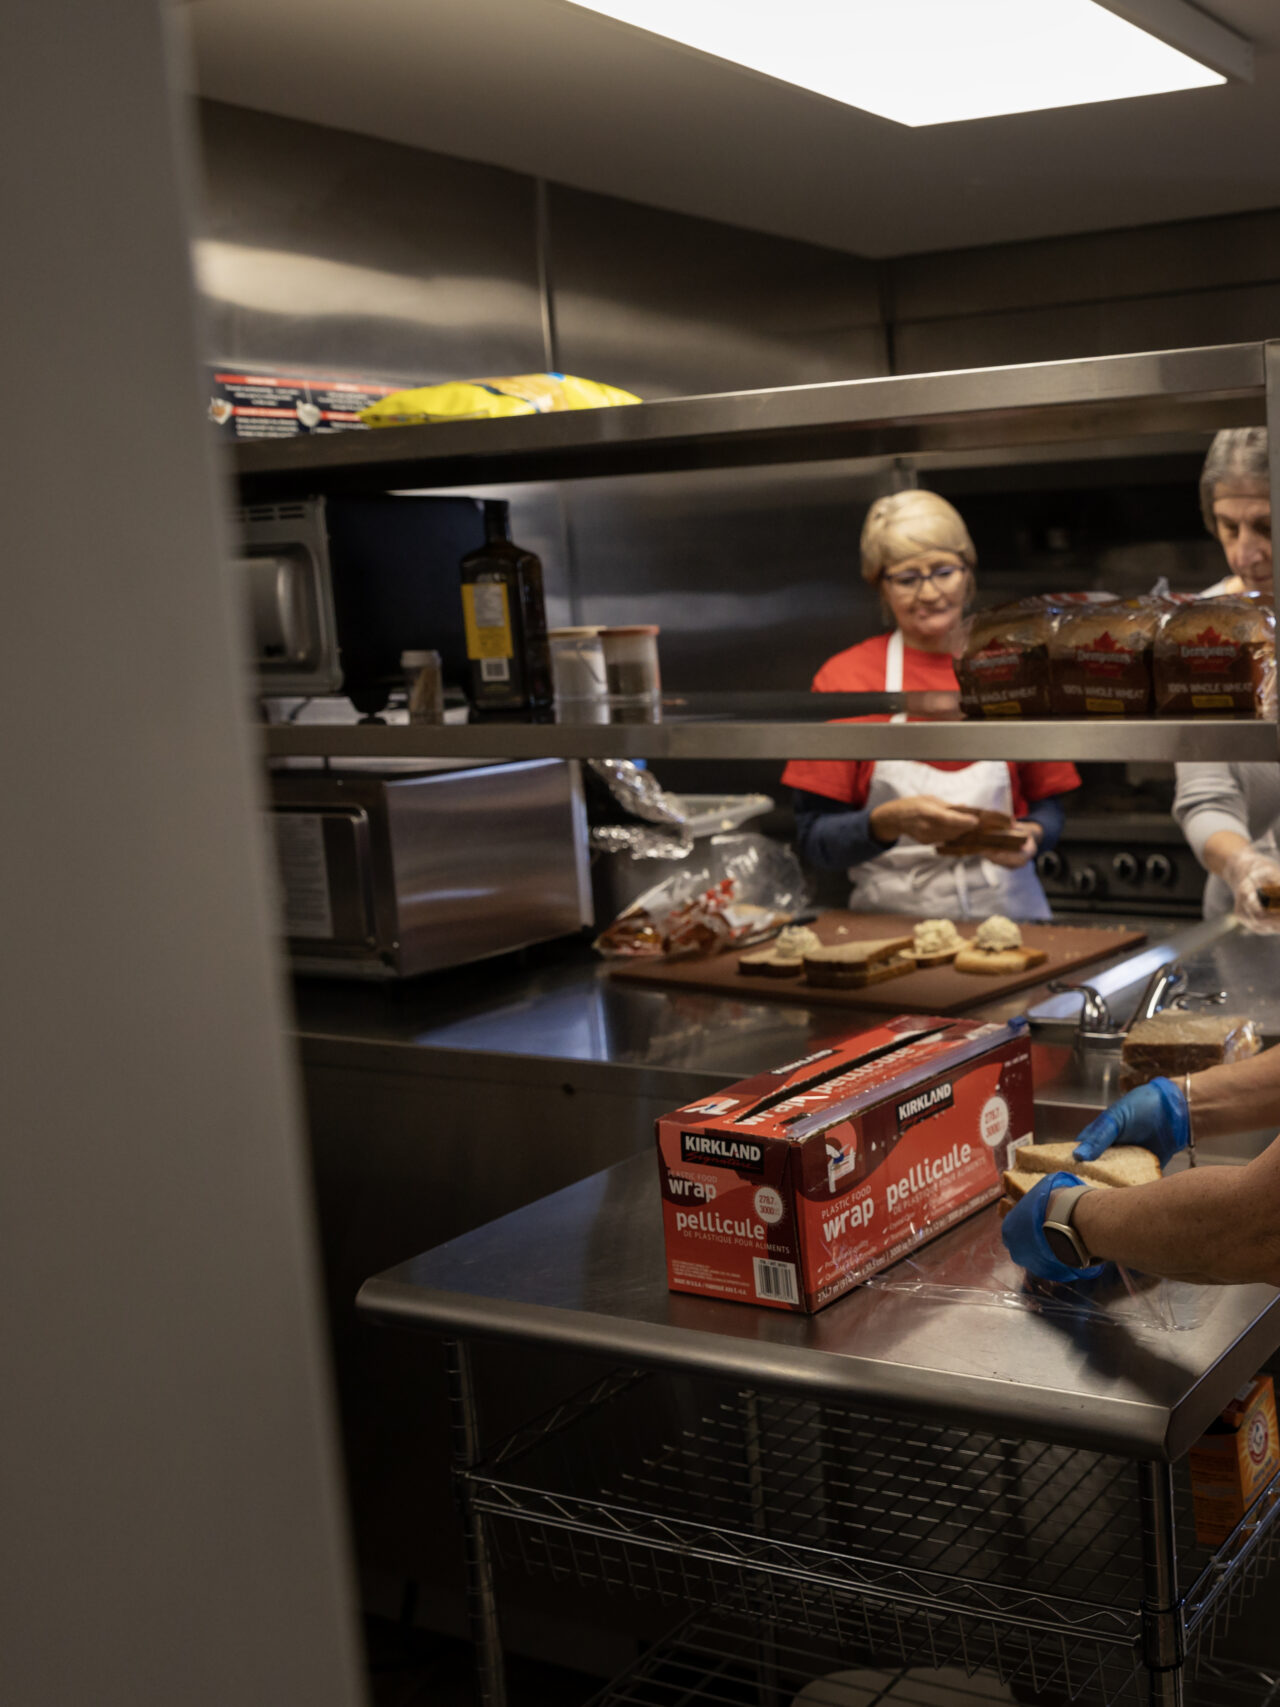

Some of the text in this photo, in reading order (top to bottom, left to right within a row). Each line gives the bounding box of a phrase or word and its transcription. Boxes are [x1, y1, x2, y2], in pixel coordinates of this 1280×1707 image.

[898, 1083, 952, 1121] KIRKLAND
[684, 1135, 762, 1162] KIRKLAND
[668, 1178, 717, 1204] wrap
[821, 1185, 872, 1220] PLASTIC FOOD
[823, 1198, 874, 1242] wrap
[886, 1143, 972, 1213] pellicule
[675, 1210, 765, 1241] pellicule
[683, 1228, 791, 1255] DE PLASTIQUE POUR ALIMENTS
